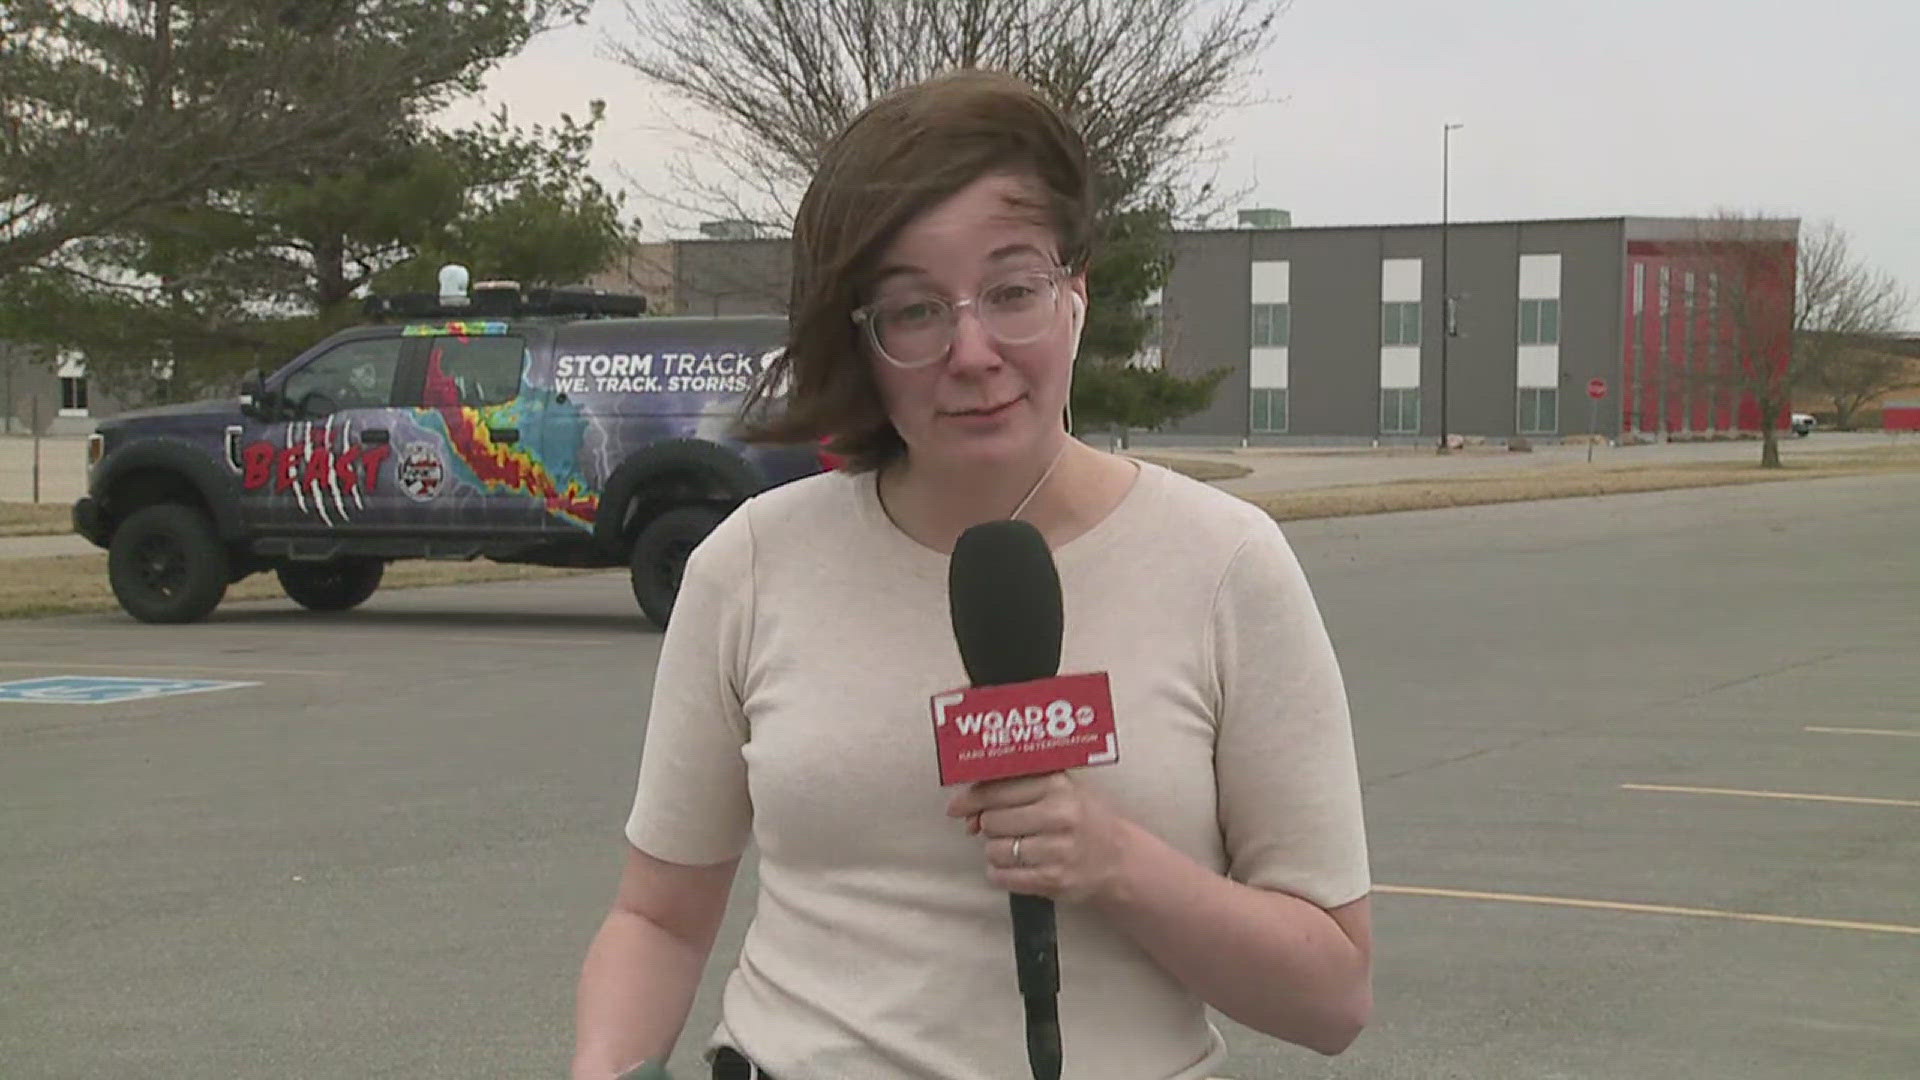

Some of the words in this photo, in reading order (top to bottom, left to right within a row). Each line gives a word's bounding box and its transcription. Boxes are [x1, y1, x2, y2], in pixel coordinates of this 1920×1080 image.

[556, 354, 653, 377] STORM
[661, 352, 754, 375] TRACK
[555, 376, 589, 394] WE.
[596, 376, 662, 393] TRACK.
[242, 440, 391, 495] BEAST
[955, 706, 1043, 736] WQAD
[1045, 699, 1077, 738] 8
[982, 723, 1046, 748] NEWS
